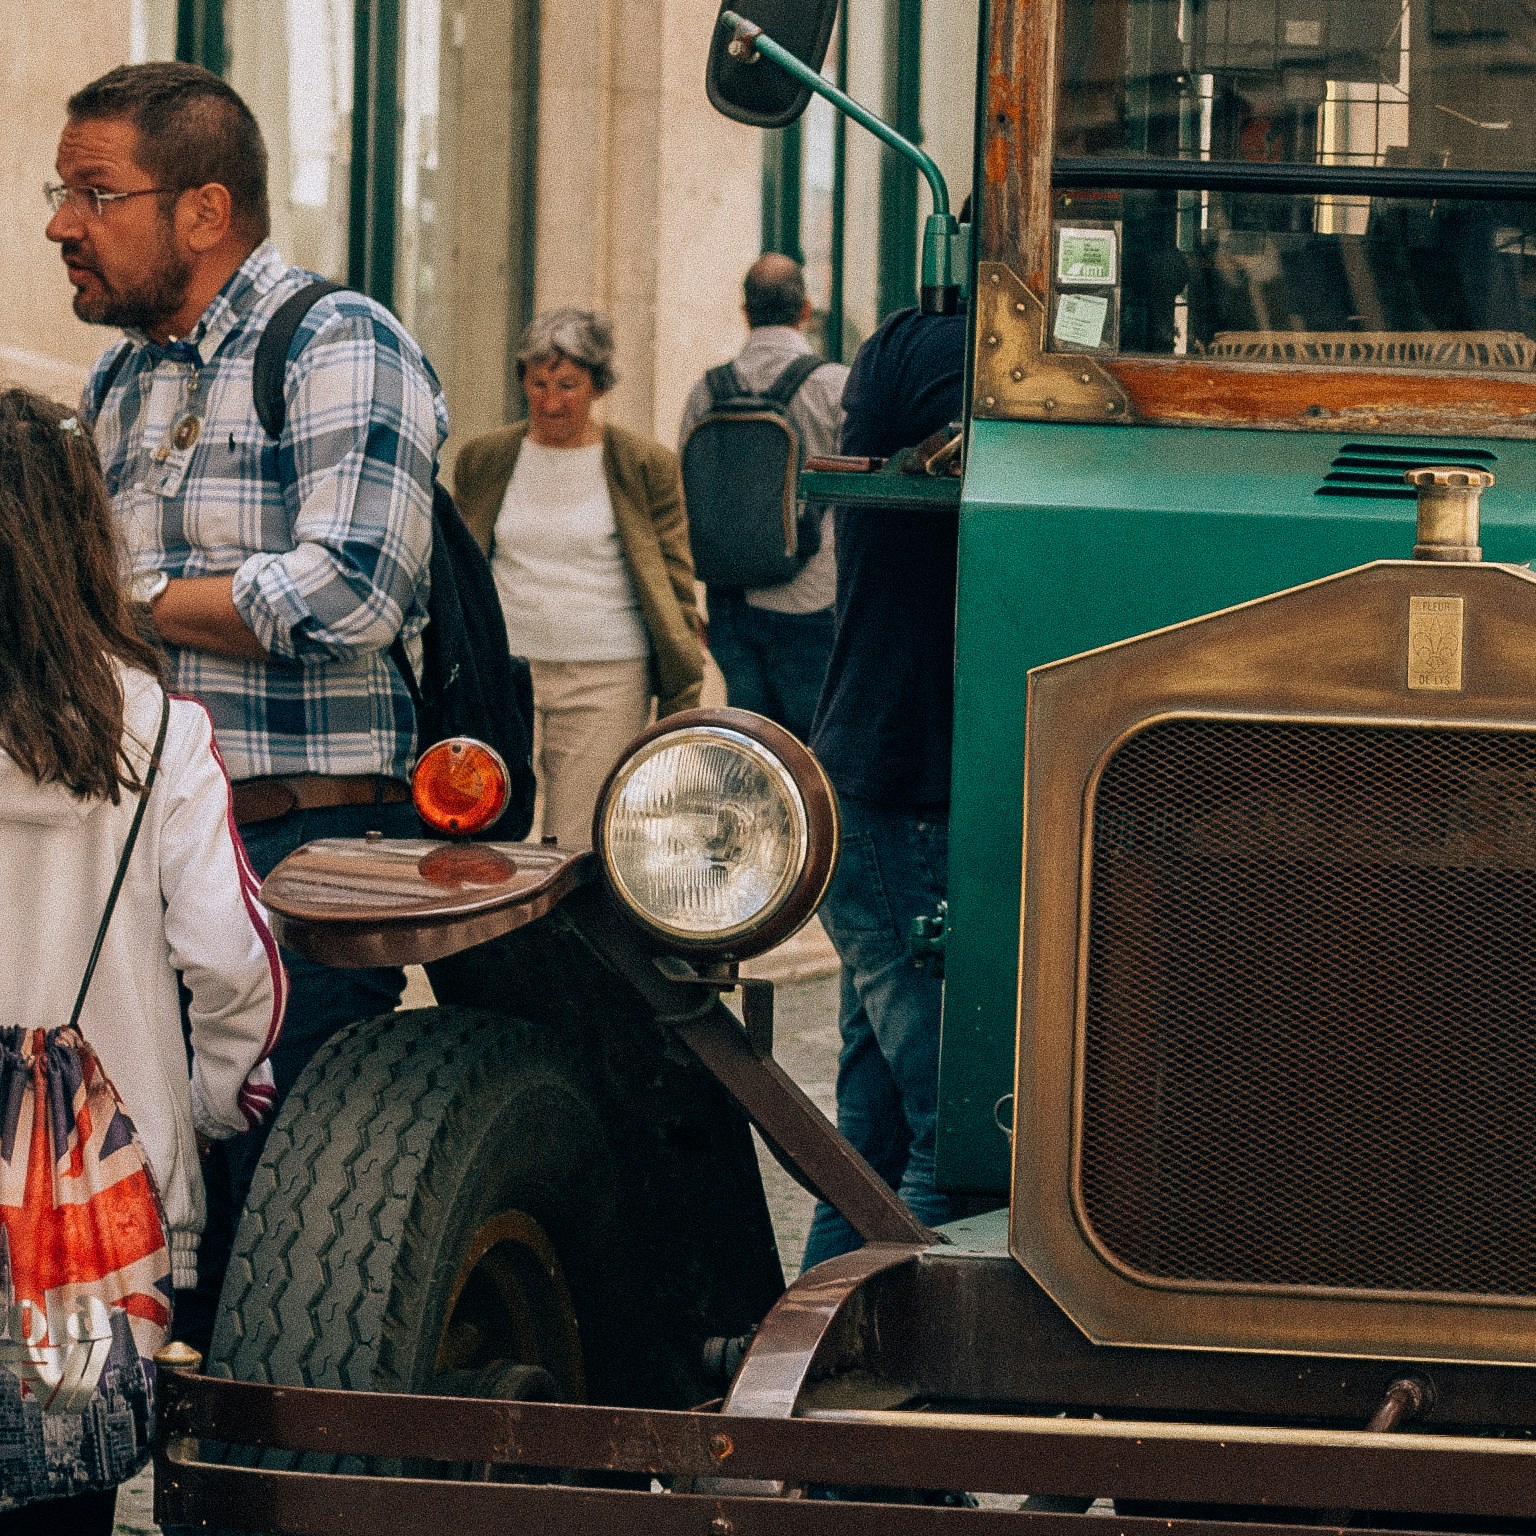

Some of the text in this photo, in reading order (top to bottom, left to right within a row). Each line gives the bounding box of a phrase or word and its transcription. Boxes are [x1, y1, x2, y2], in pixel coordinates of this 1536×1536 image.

[1422, 601, 1450, 612] FLEUR
[1419, 674, 1450, 685] DE LYS
